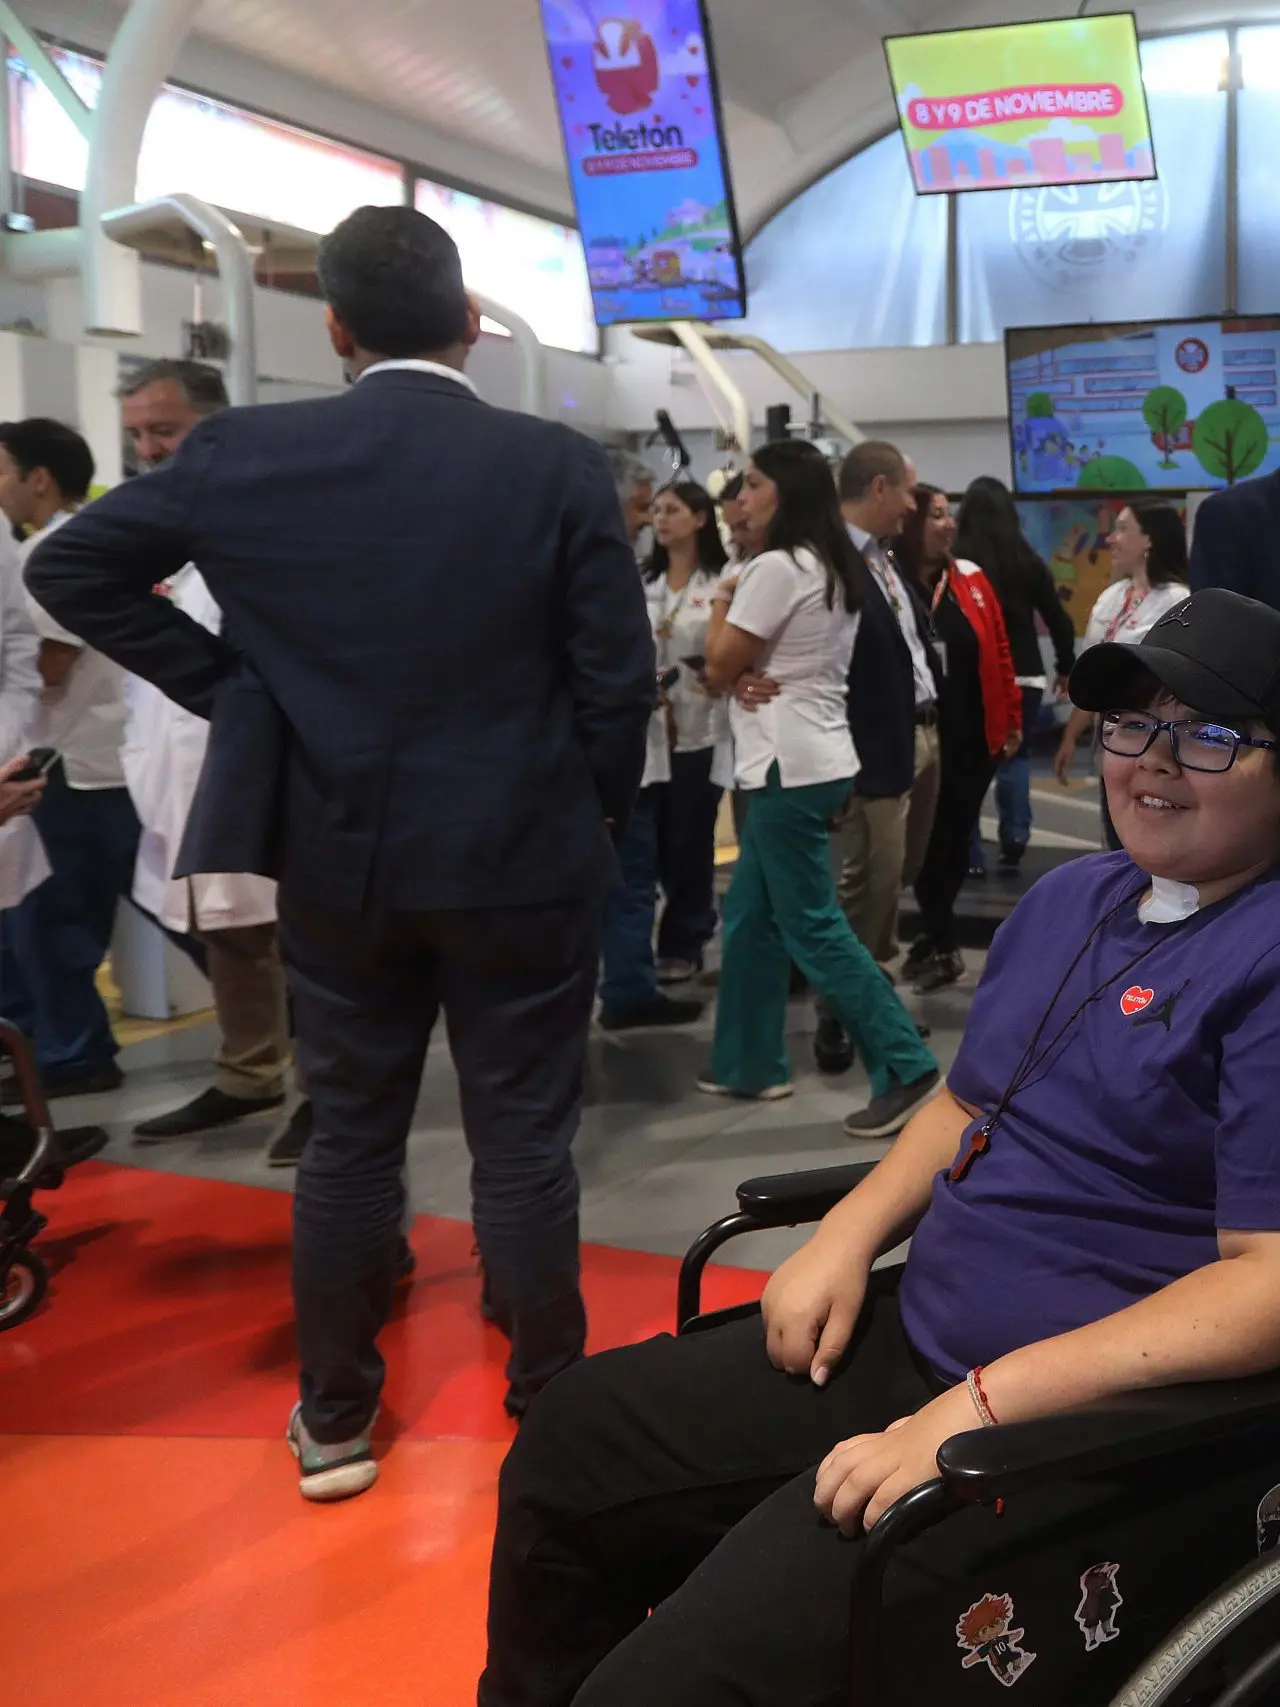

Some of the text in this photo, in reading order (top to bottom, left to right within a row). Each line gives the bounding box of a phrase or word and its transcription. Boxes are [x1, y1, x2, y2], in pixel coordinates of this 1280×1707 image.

[915, 89, 1115, 125] 8 Y 9 DE NOVIEMBRE
[995, 1641, 1006, 1655] 10
